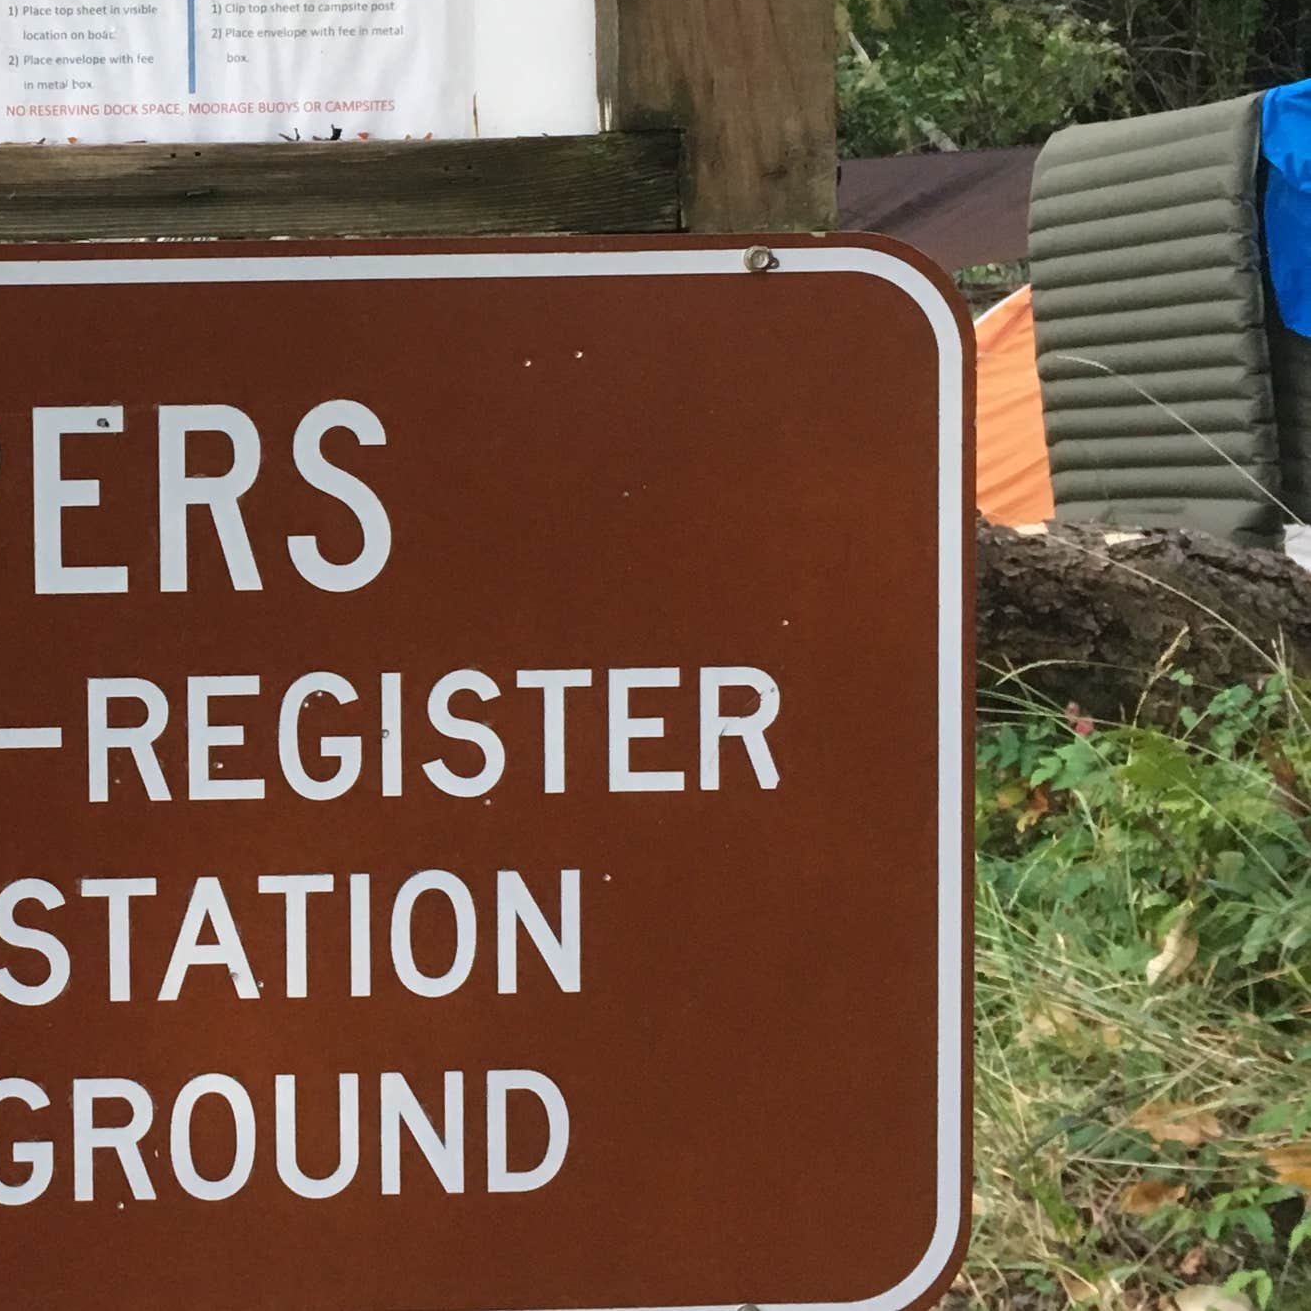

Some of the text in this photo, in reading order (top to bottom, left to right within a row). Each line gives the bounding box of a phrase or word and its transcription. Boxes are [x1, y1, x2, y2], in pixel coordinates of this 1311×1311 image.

[8, 6, 18, 17] 1)
[22, 5, 52, 16] Place
[54, 6, 74, 18] top
[76, 5, 107, 15] sheet
[110, 5, 120, 15] in
[212, 1, 395, 15] 1) Clip top sheet to campsite post
[23, 30, 68, 41] location
[70, 31, 85, 40] on
[212, 25, 404, 39] 2) Place envelope with fee in metal
[8, 53, 154, 67] 2) Place envelope with fee
[24, 80, 34, 90] in
[6, 104, 27, 117] NO
[29, 104, 100, 117] RESERVING
[103, 103, 139, 116] DOCK
[188, 101, 254, 115] MOORAGE
[258, 101, 300, 114] BUOYS
[303, 101, 321, 114] OR
[324, 100, 395, 113] CAMPSITES
